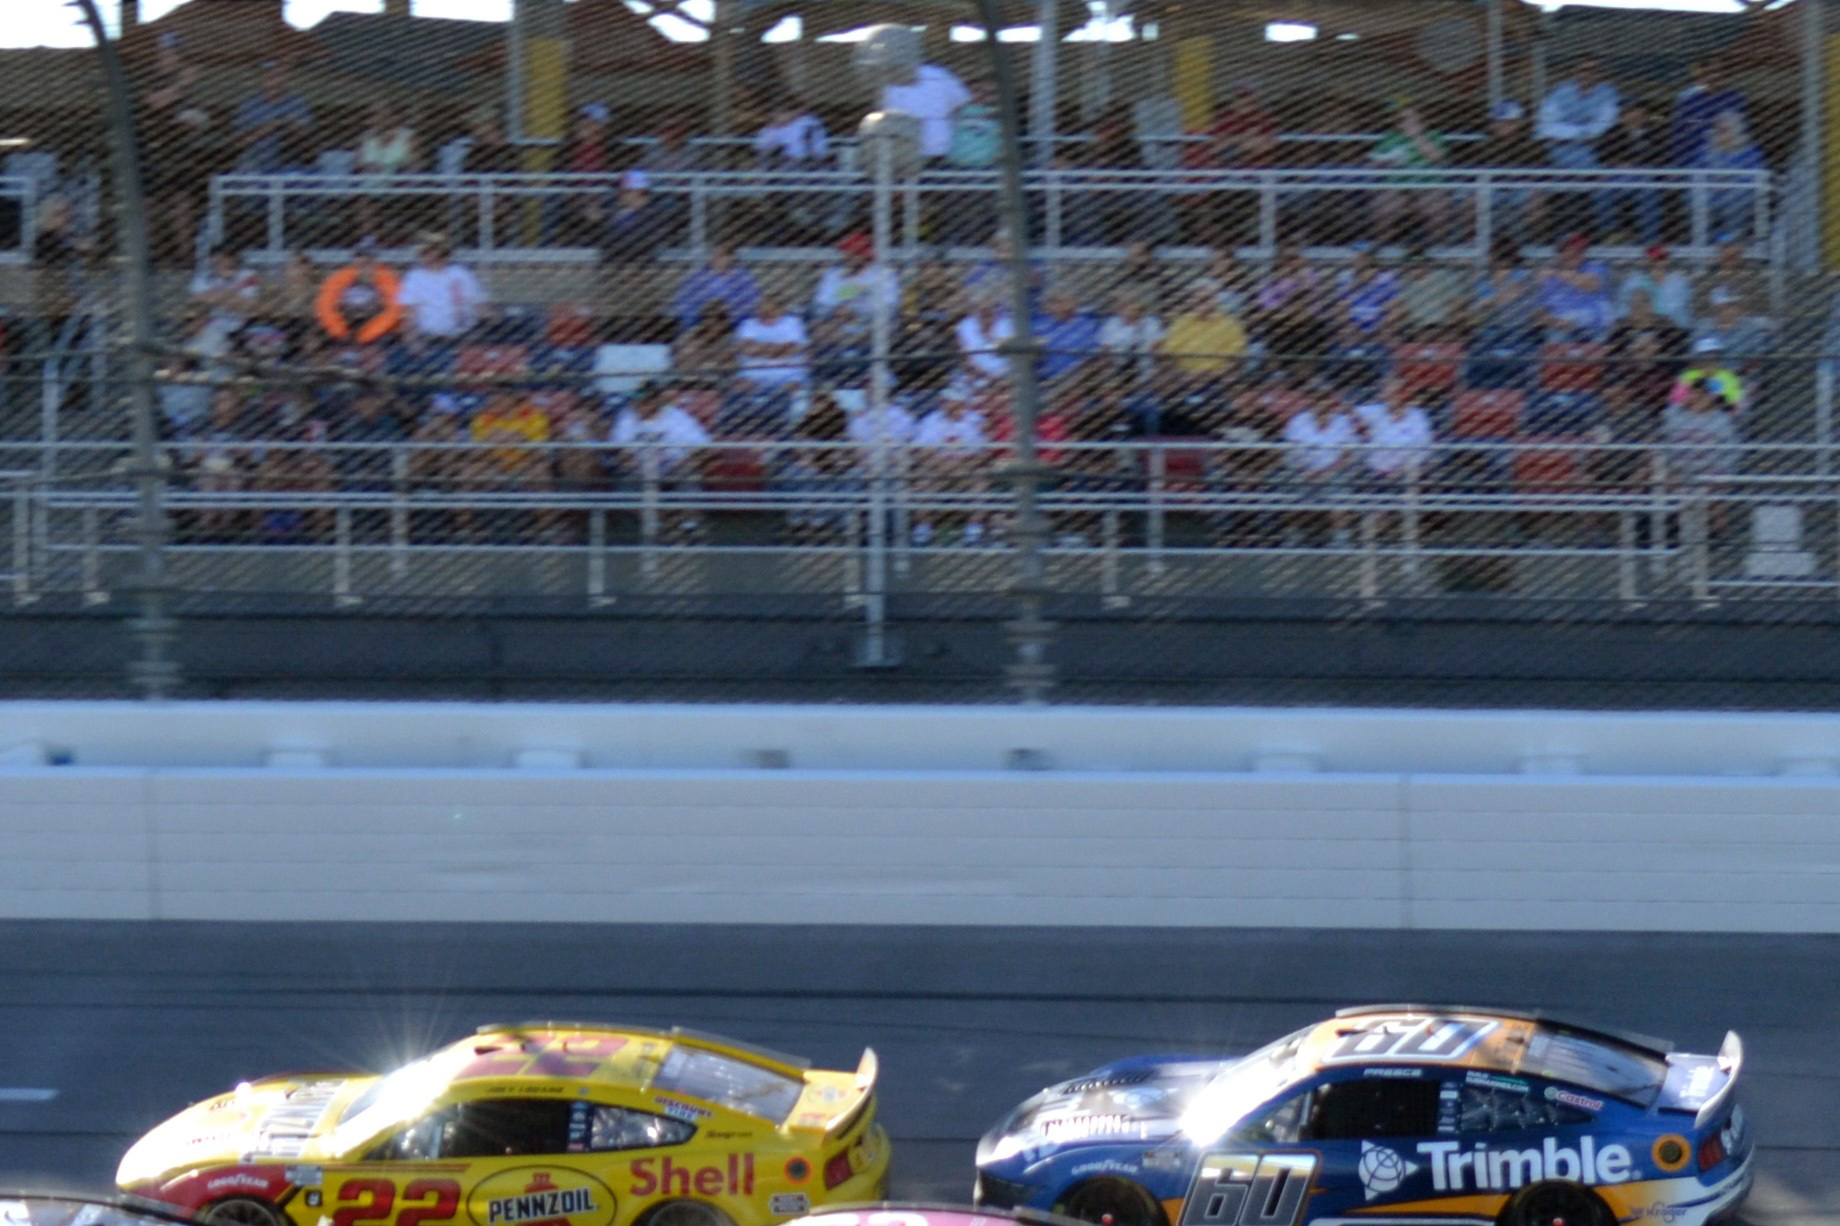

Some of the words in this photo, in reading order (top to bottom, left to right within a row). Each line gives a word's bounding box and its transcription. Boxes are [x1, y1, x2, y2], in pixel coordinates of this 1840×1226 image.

[629, 1153, 755, 1196] Shell
[1416, 1136, 1633, 1190] Trimble
[487, 1186, 596, 1224] PENNZOIL
